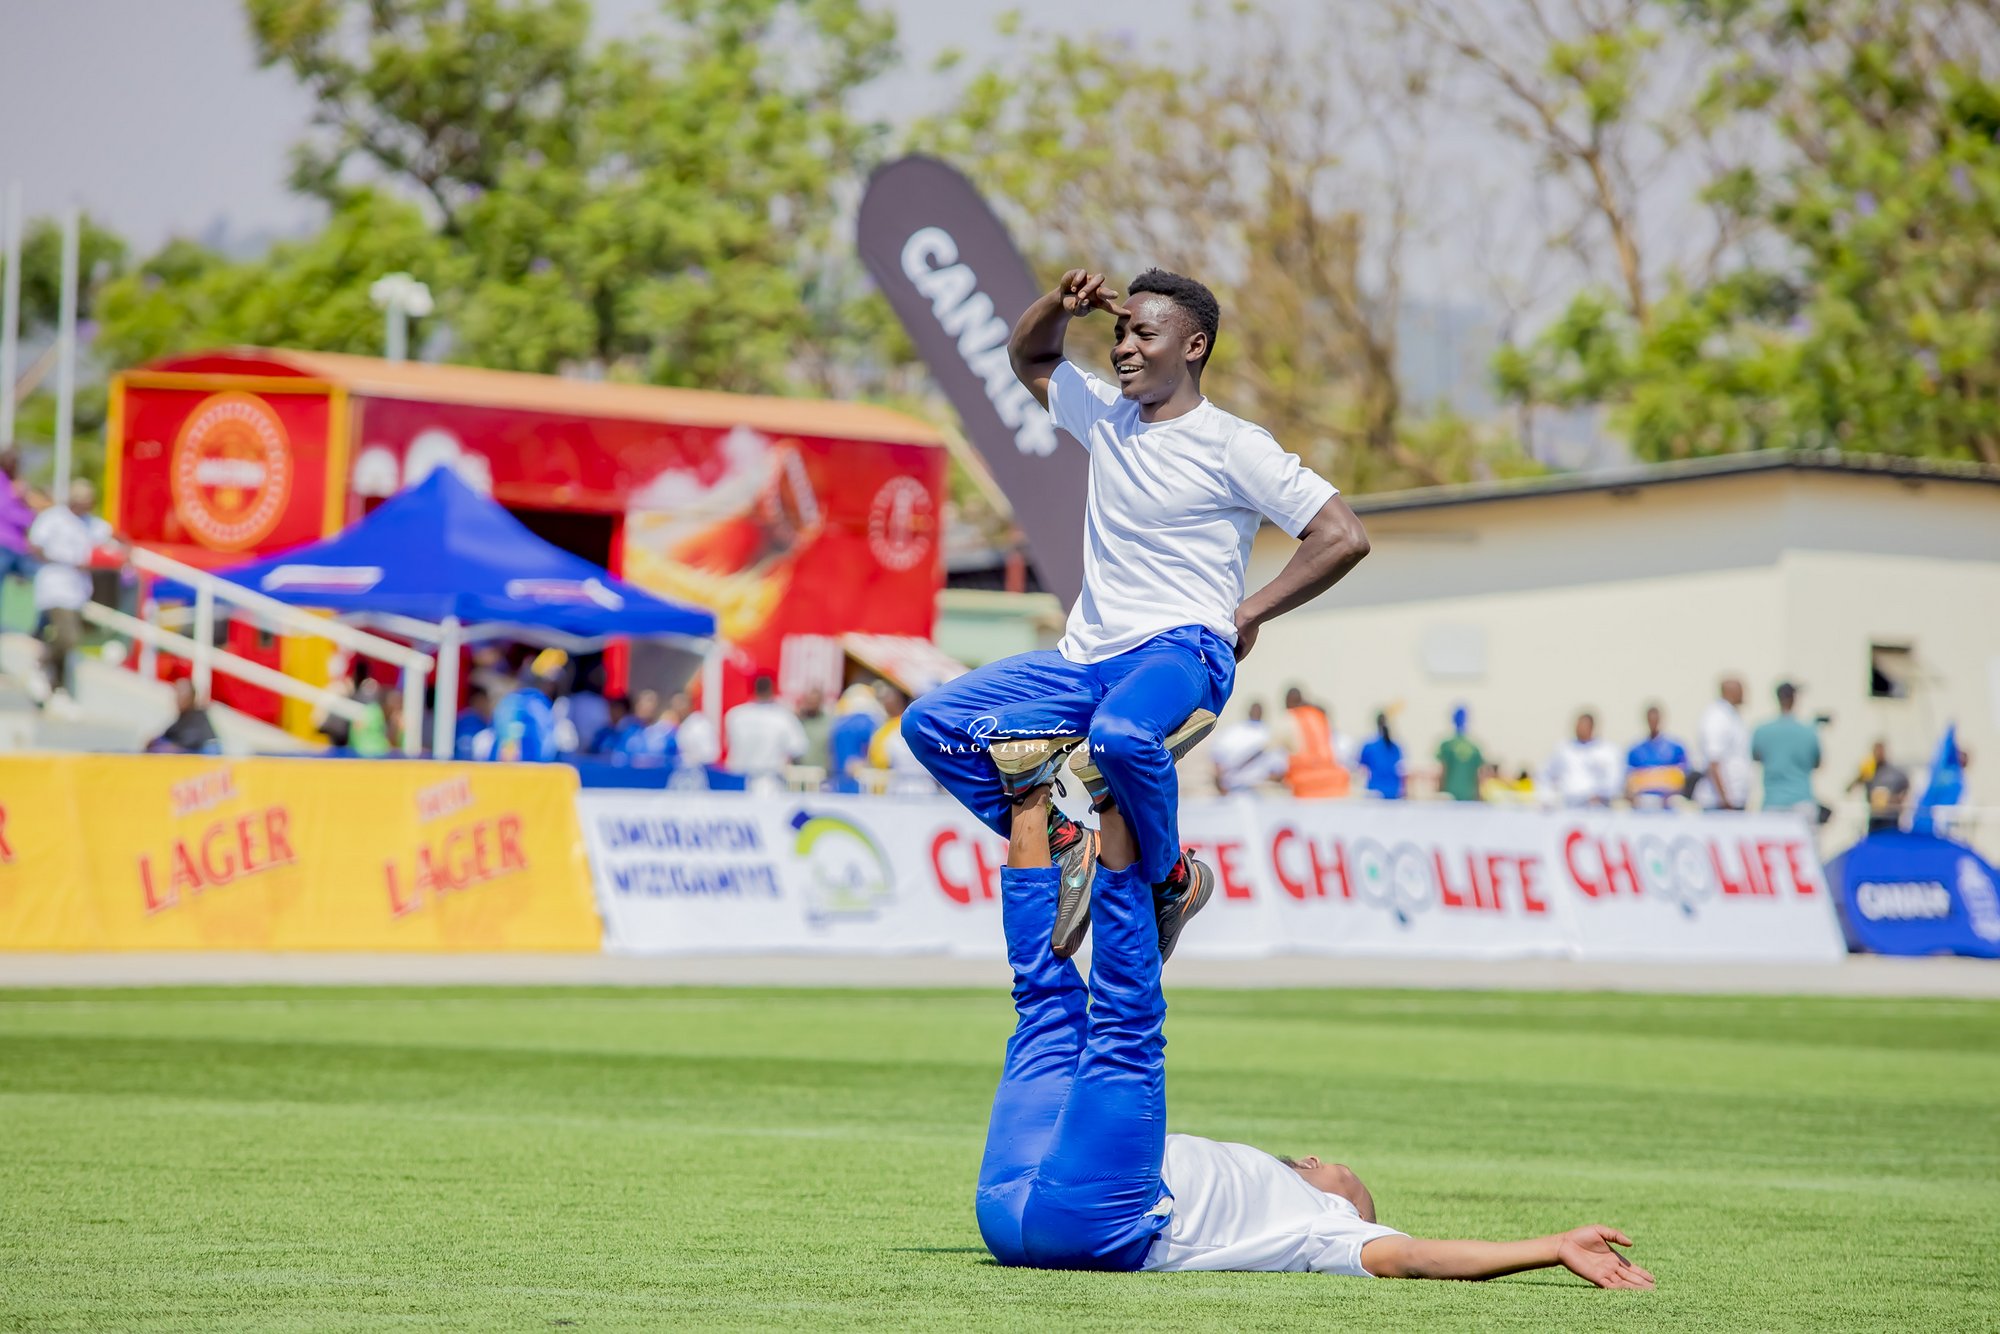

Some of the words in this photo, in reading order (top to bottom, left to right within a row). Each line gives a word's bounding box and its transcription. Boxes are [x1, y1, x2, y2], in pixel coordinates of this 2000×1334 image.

[901, 226, 1058, 457] CANAL+
[138, 806, 296, 916] LAGER
[385, 813, 528, 917] LAGER
